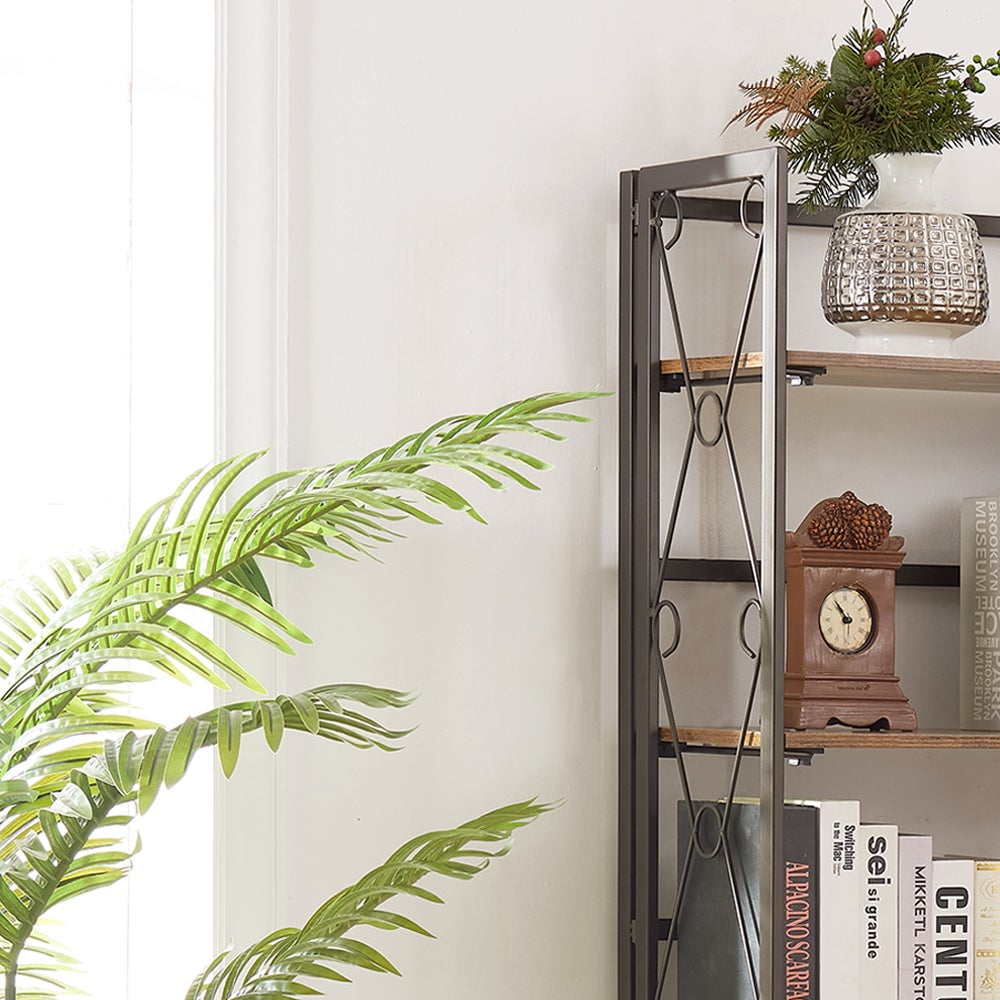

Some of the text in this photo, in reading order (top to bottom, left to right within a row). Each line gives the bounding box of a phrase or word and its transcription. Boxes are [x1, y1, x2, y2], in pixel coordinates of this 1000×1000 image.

[975, 501, 987, 592] MUSEUM
[988, 501, 998, 592] BROOKLYN
[974, 651, 984, 720] MUSEUM
[983, 651, 992, 720] BROOKLYN
[833, 841, 844, 862] Mac
[843, 825, 856, 871] Switching
[786, 861, 810, 939] ALPACINO
[864, 836, 892, 959] sei si grande
[914, 865, 926, 938] MIKKETL
